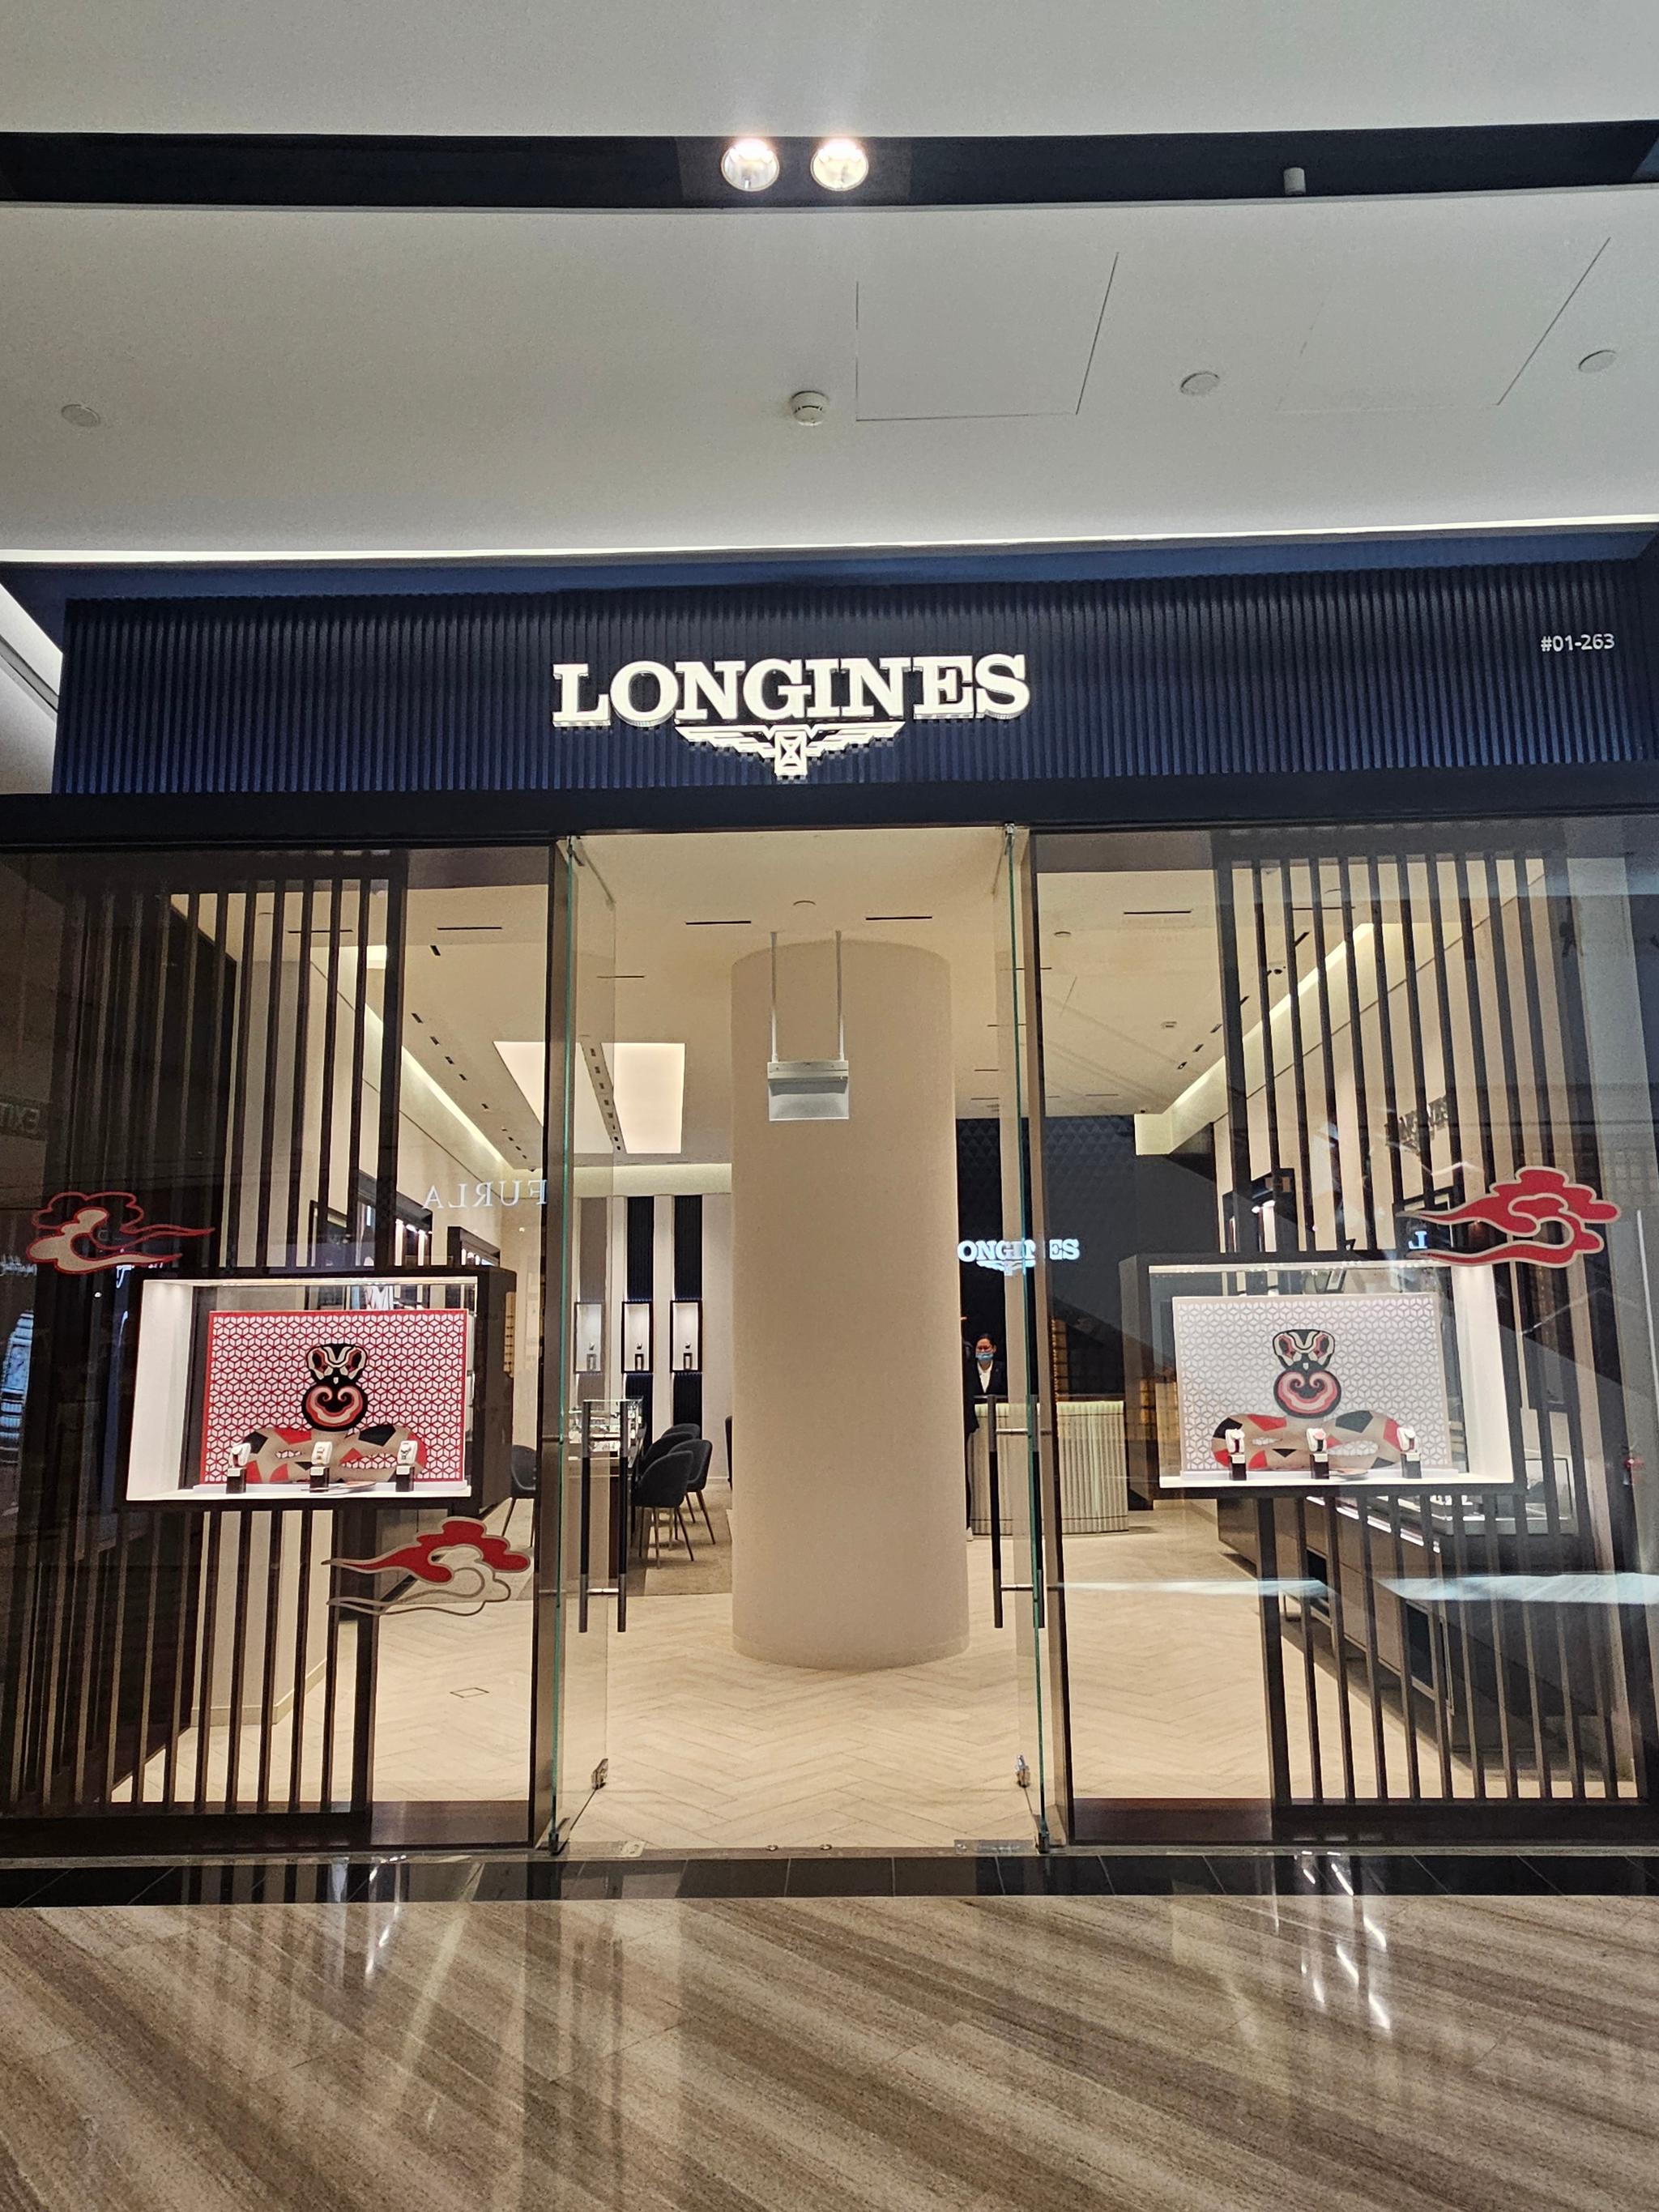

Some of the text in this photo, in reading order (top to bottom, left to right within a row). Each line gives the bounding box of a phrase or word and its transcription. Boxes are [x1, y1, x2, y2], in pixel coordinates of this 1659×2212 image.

[1541, 633, 1615, 652] #01-263
[552, 653, 1030, 727] LONGINES
[957, 1238, 1080, 1262] ONGINES
